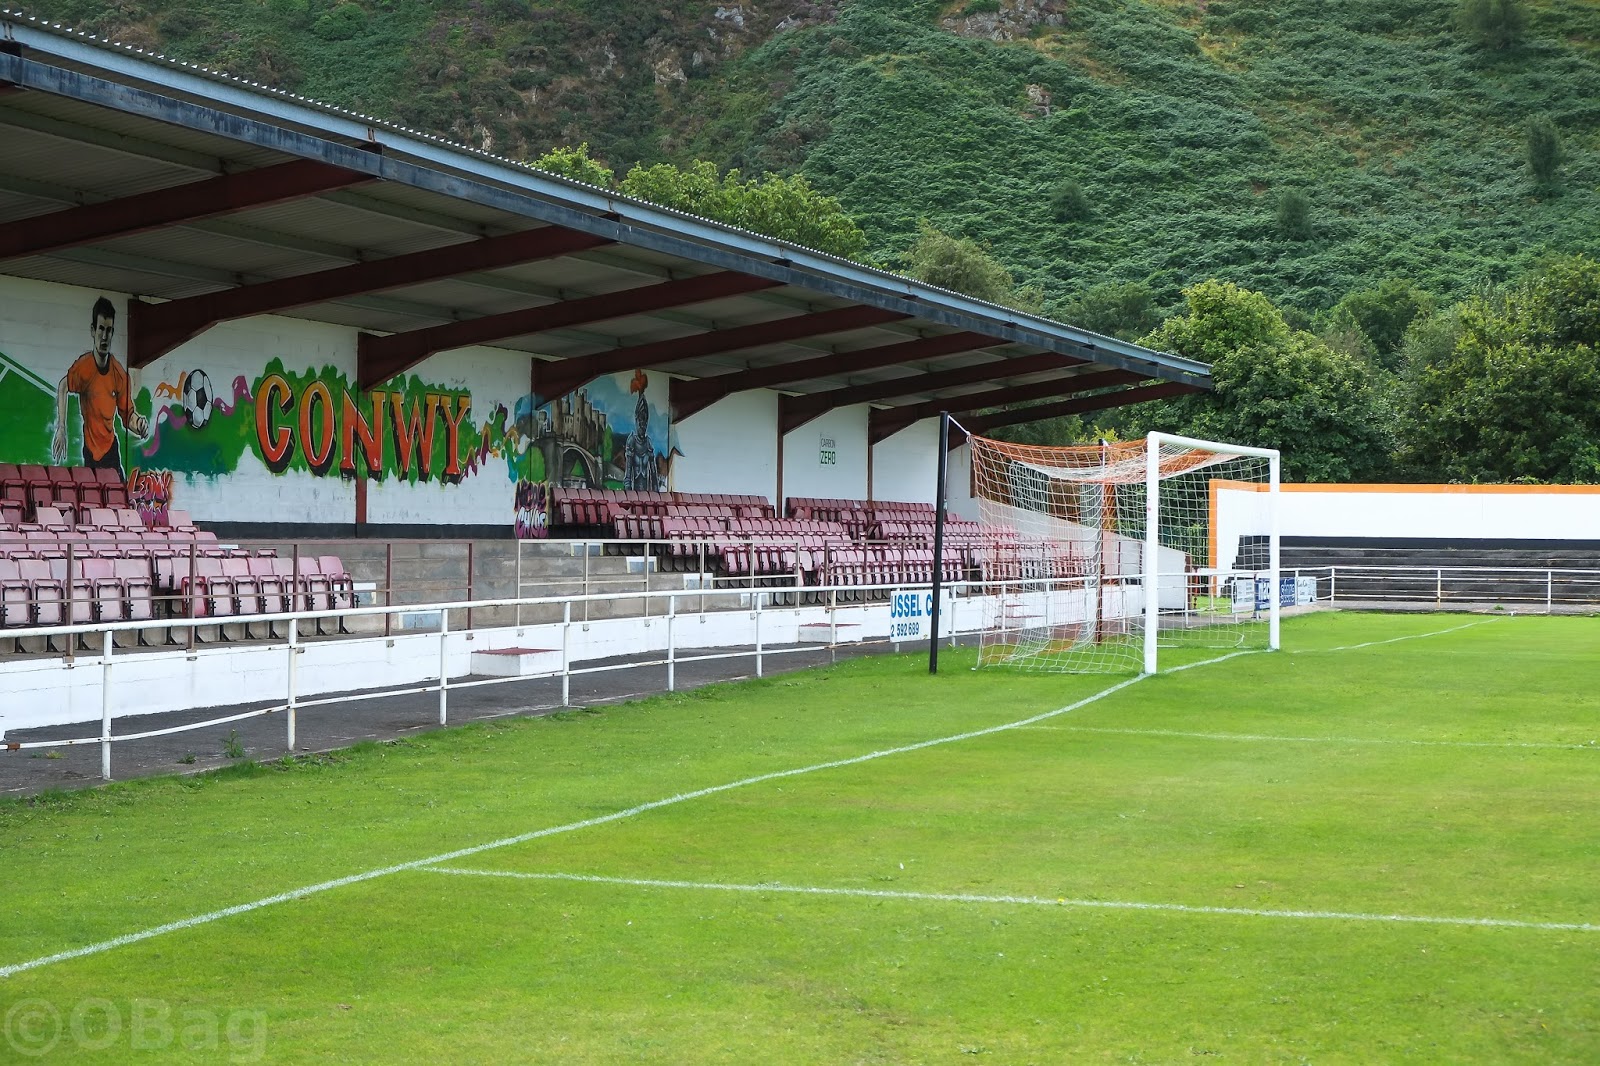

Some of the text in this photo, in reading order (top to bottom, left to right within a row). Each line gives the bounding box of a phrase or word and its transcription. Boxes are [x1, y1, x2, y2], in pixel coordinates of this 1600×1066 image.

[255, 374, 472, 484] CONWY
[820, 450, 836, 465] ZERO
[891, 624, 895, 637] 2
